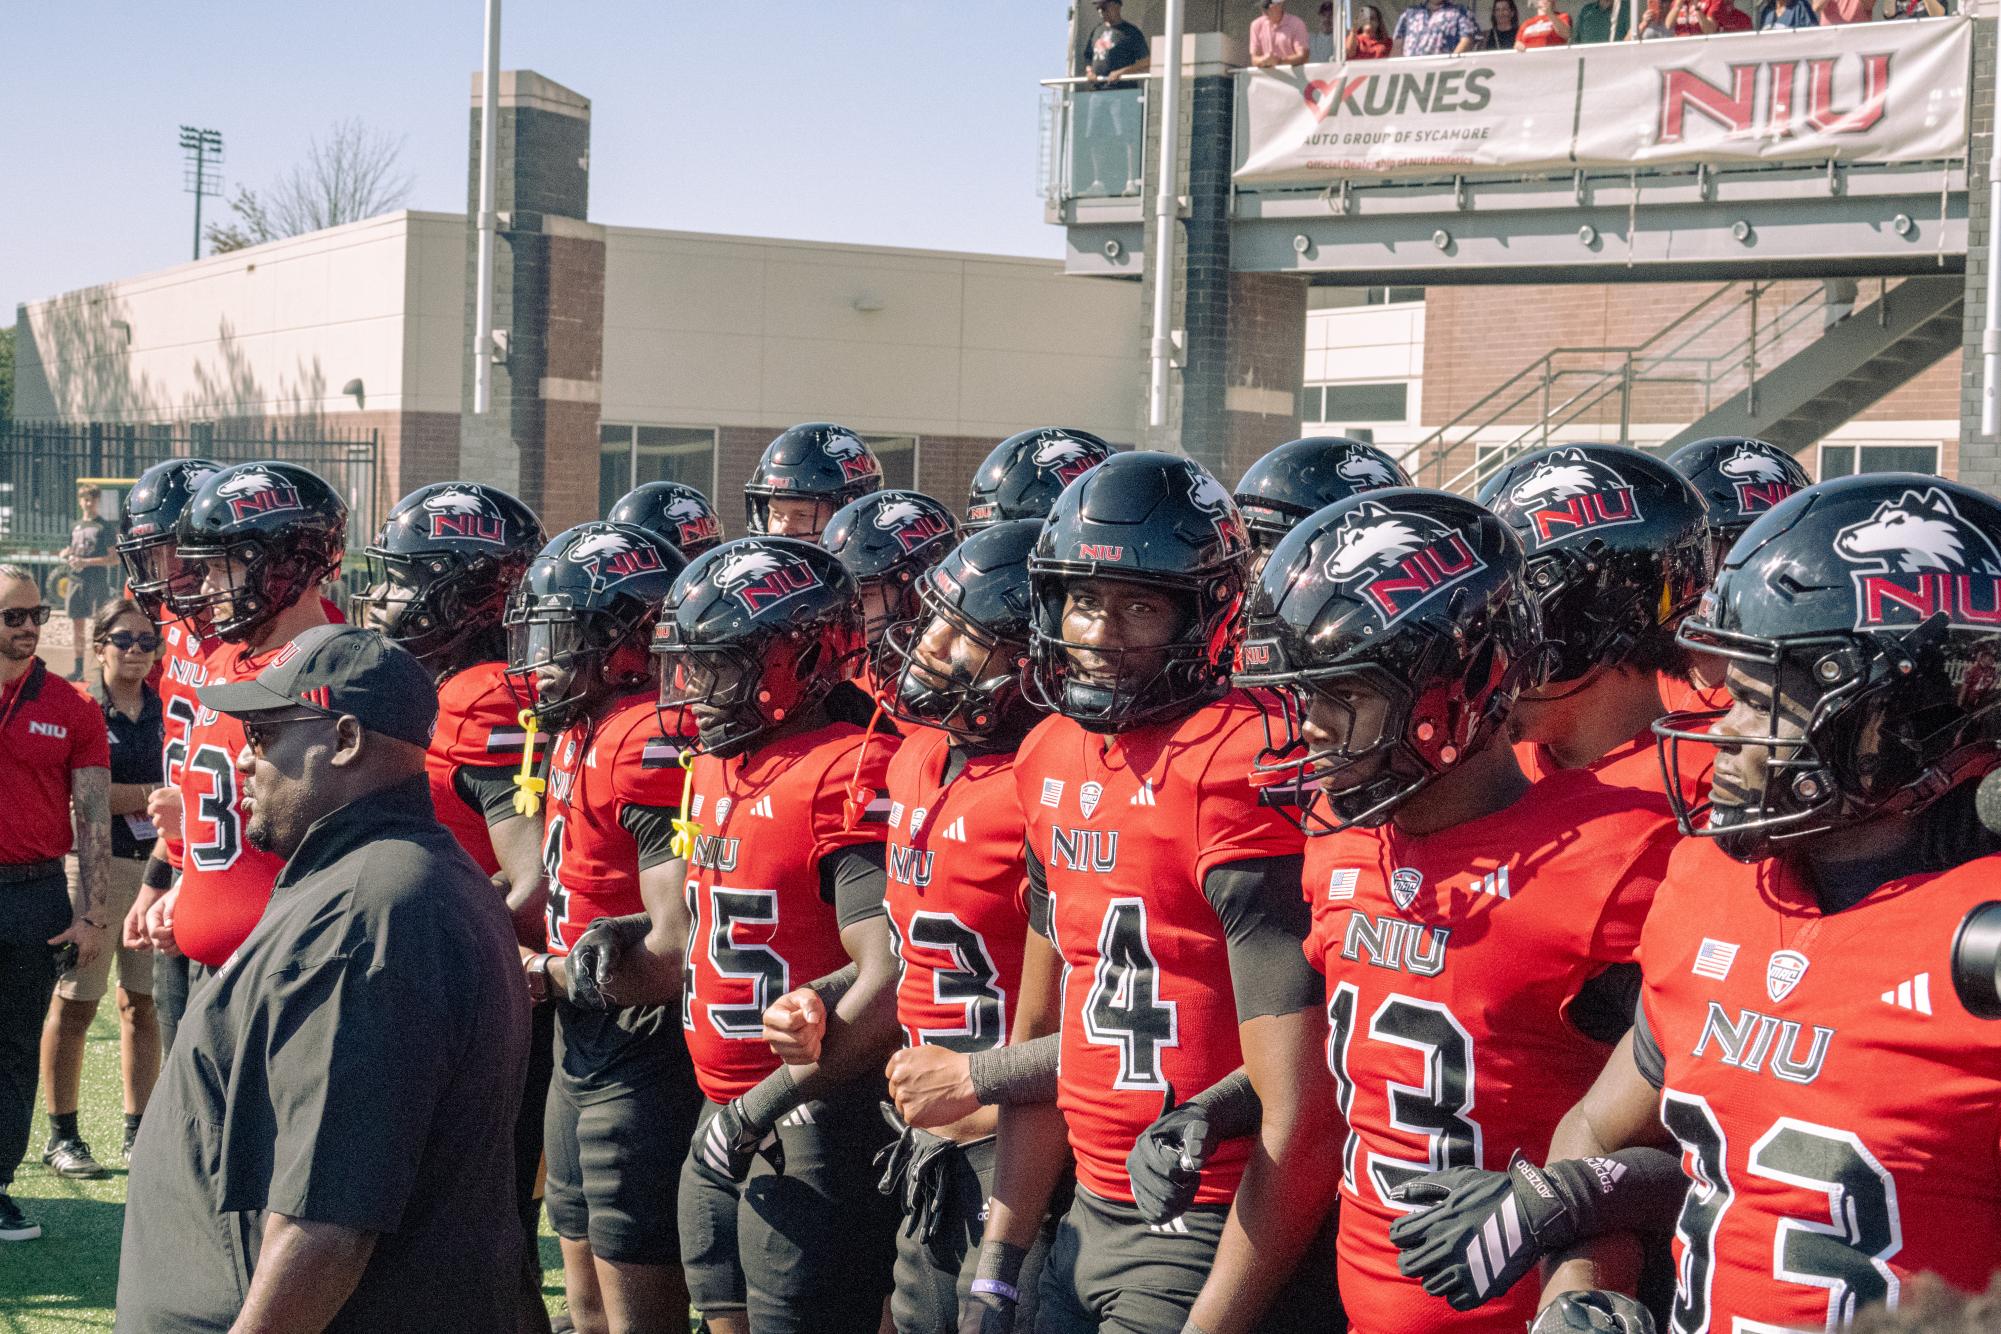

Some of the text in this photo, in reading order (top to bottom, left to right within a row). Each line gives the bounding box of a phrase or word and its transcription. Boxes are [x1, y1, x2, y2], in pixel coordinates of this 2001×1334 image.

[1326, 67, 1496, 117] KUNES
[1655, 52, 1897, 145] NIU
[1303, 133, 1339, 146] AUTO
[1394, 130, 1412, 144] OF
[1415, 127, 1490, 142] SYCAMORE
[231, 486, 301, 521] NIU
[971, 506, 993, 520] NIU
[1534, 485, 1635, 541] NIU
[434, 513, 502, 540] NIU
[682, 514, 719, 541] NIU
[898, 511, 949, 550] NIU
[1079, 543, 1123, 562] NIU
[741, 562, 819, 612] NIU
[1367, 534, 1476, 617] NIU
[1864, 573, 2001, 625] NIU
[167, 655, 209, 688] NIU
[1244, 645, 1270, 665] NIU
[28, 720, 68, 740] NIU
[691, 834, 741, 873] NIU
[889, 842, 936, 888] NIU
[1049, 825, 1119, 873] NIU
[1341, 911, 1453, 978] NIU
[1047, 891, 1179, 1091] 4
[1692, 1000, 1836, 1085] NIU
[1327, 981, 1484, 1213] 13
[1515, 1159, 1555, 1199] ADIZERO
[1582, 1156, 1614, 1194] adidas
